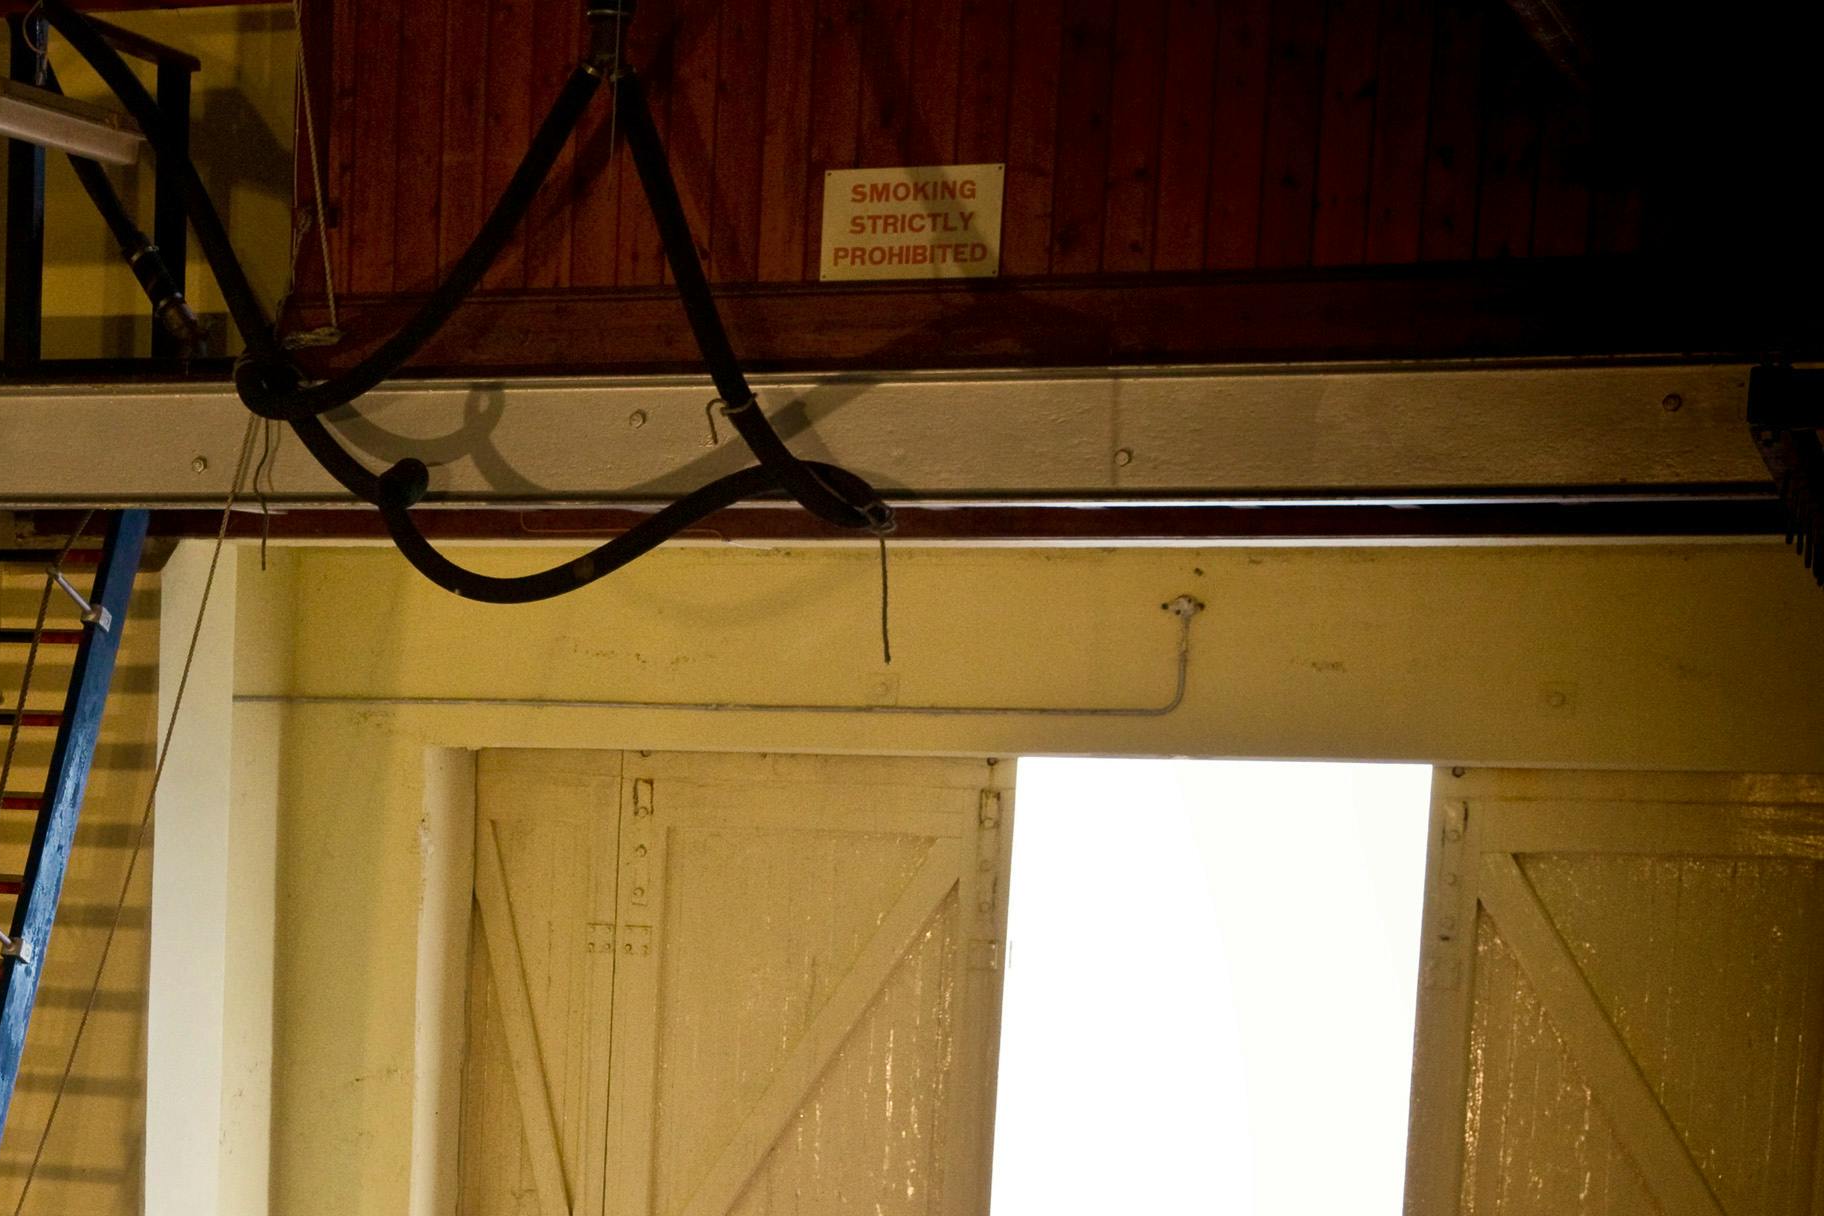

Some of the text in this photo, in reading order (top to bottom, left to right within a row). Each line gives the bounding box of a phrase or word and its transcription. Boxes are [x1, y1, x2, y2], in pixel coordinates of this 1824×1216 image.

[851, 180, 976, 203] SMOKING
[849, 212, 975, 234] STRICTLY
[833, 243, 987, 266] PROHIBITED
